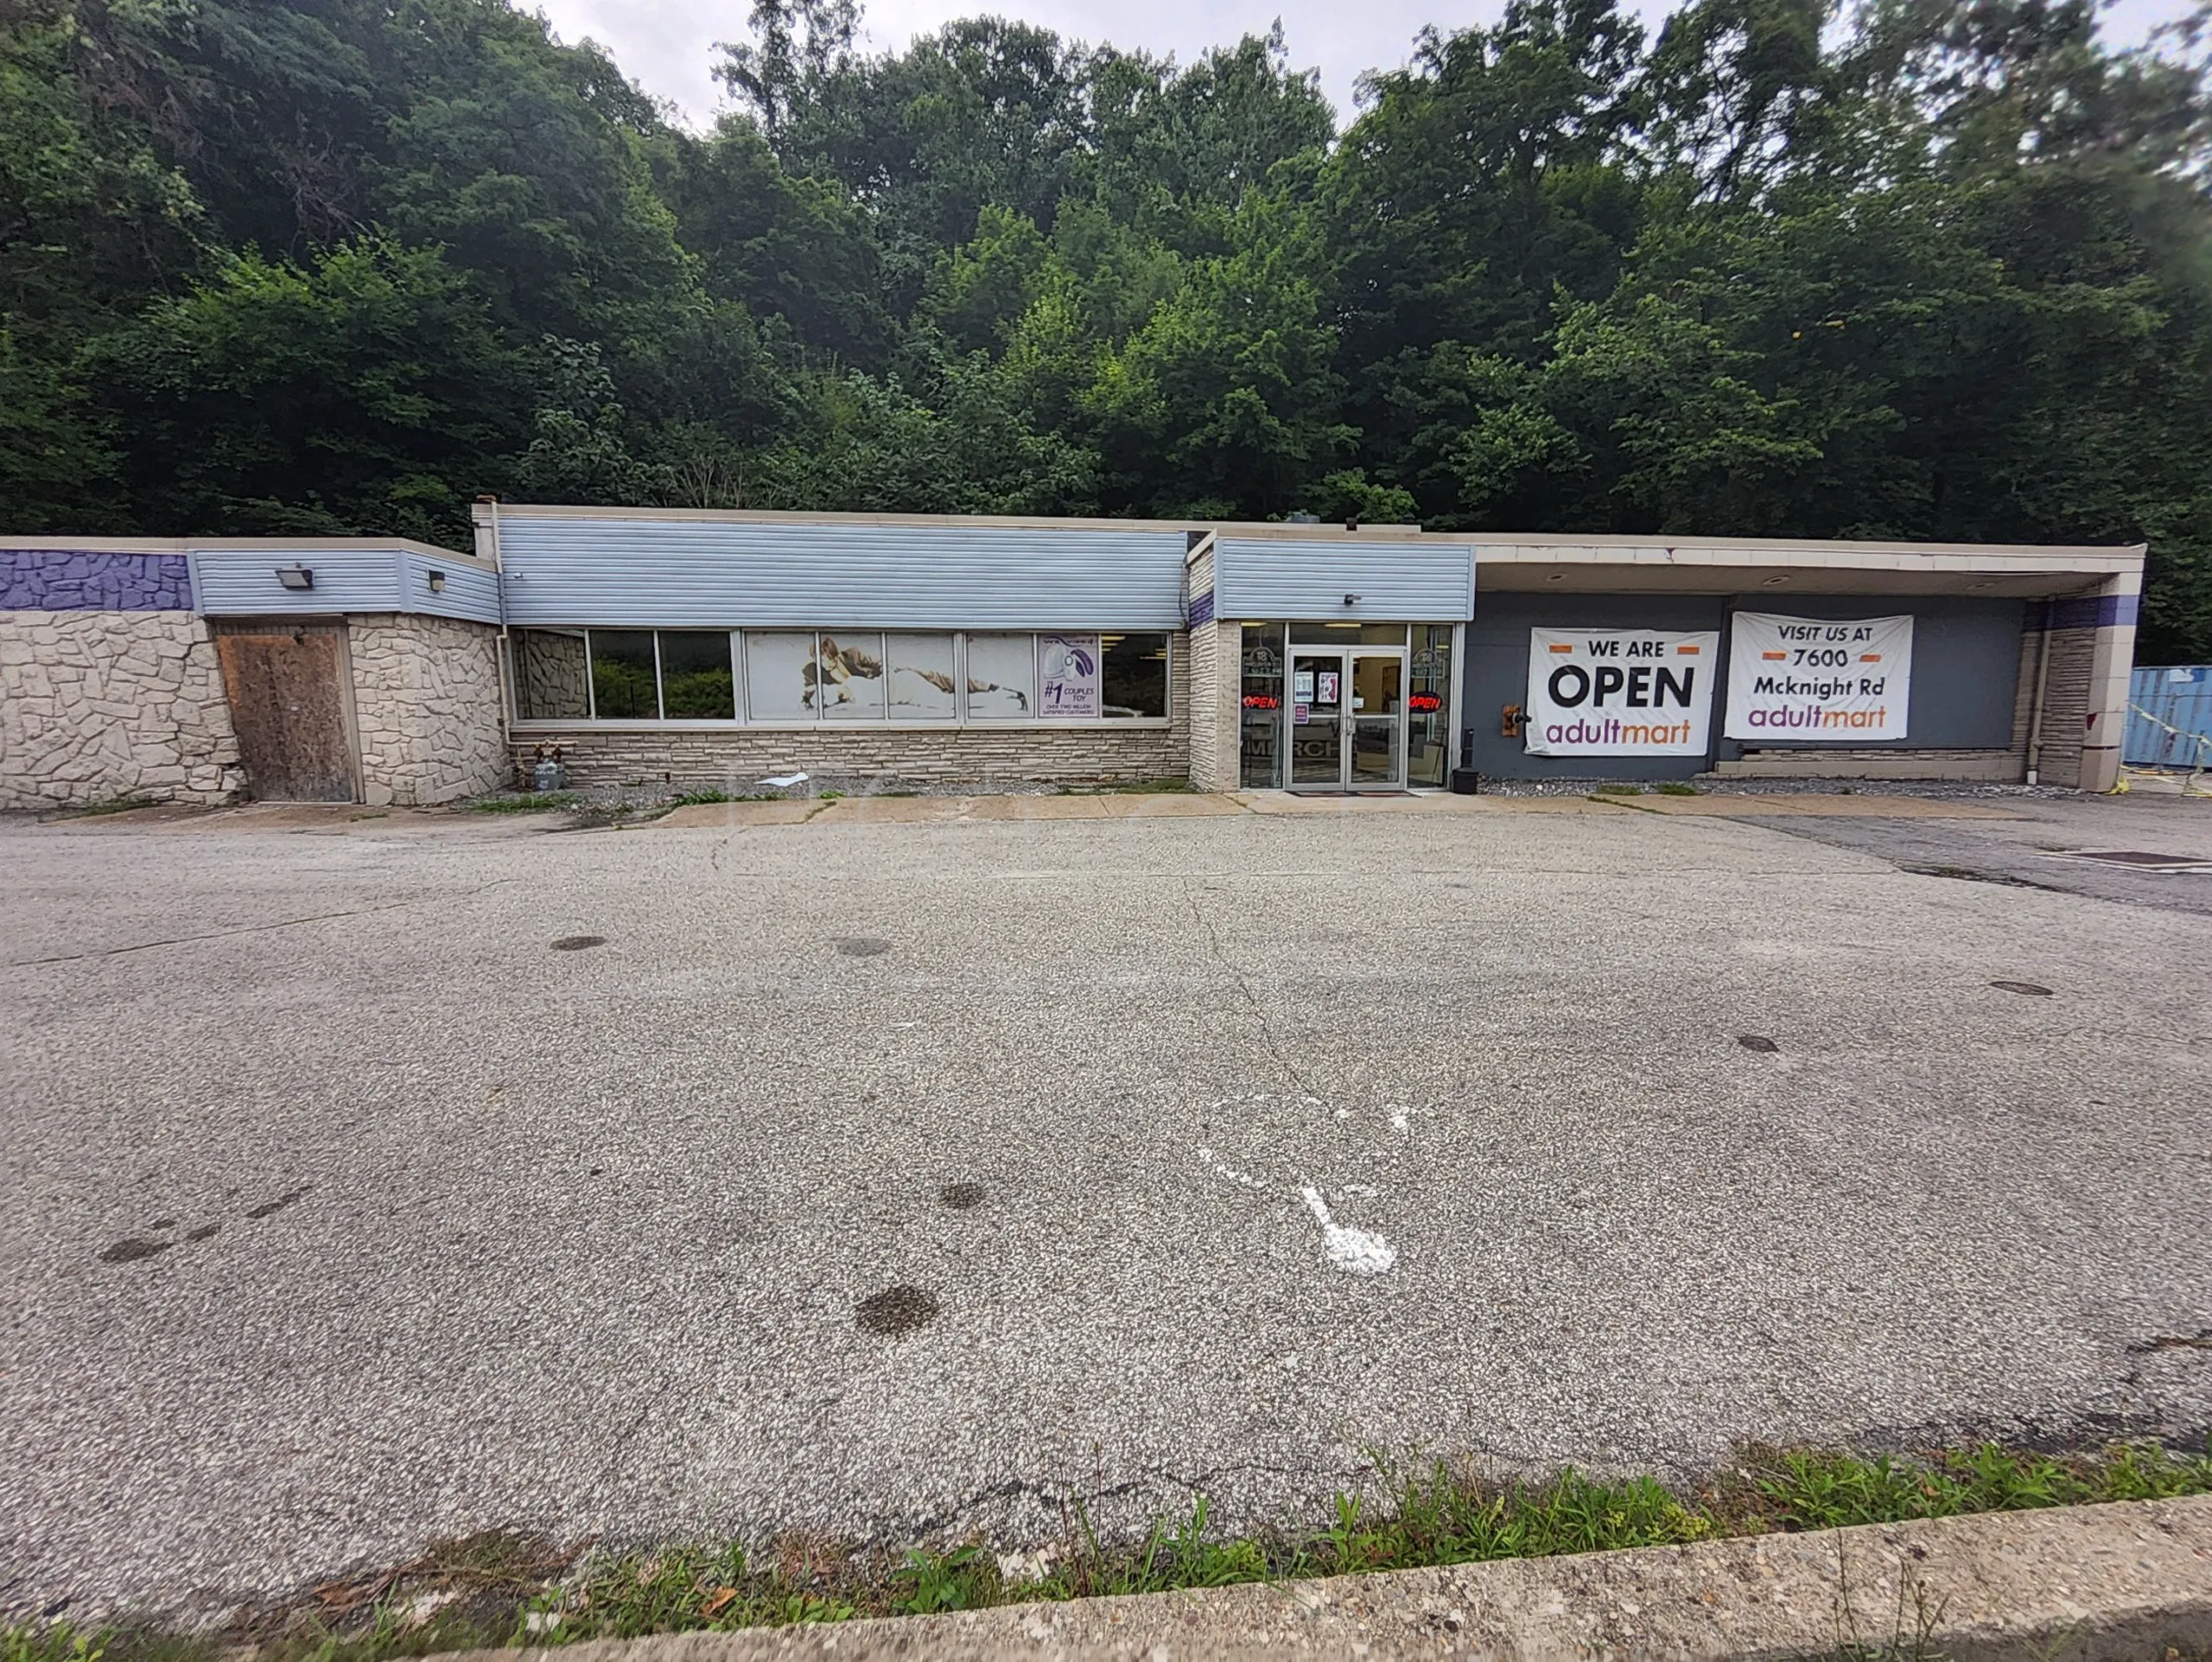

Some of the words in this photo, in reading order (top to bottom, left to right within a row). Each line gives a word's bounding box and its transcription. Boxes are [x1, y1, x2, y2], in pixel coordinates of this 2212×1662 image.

[1777, 625, 1822, 640] VISIT
[1825, 627, 1848, 641] US
[1852, 627, 1873, 641] AT
[1587, 640, 1620, 657] WE
[1625, 641, 1665, 658] ARE
[1792, 649, 1848, 667] 7600
[1044, 682, 1063, 704] #1
[1548, 665, 1695, 709] OPEN
[1753, 676, 1853, 701] Mcknight
[1859, 677, 1885, 696] Rd
[1243, 695, 1279, 710] OPEN
[1408, 695, 1441, 710] OPEN
[1748, 704, 1886, 728] adultmart
[1545, 718, 1691, 744] adultmart
